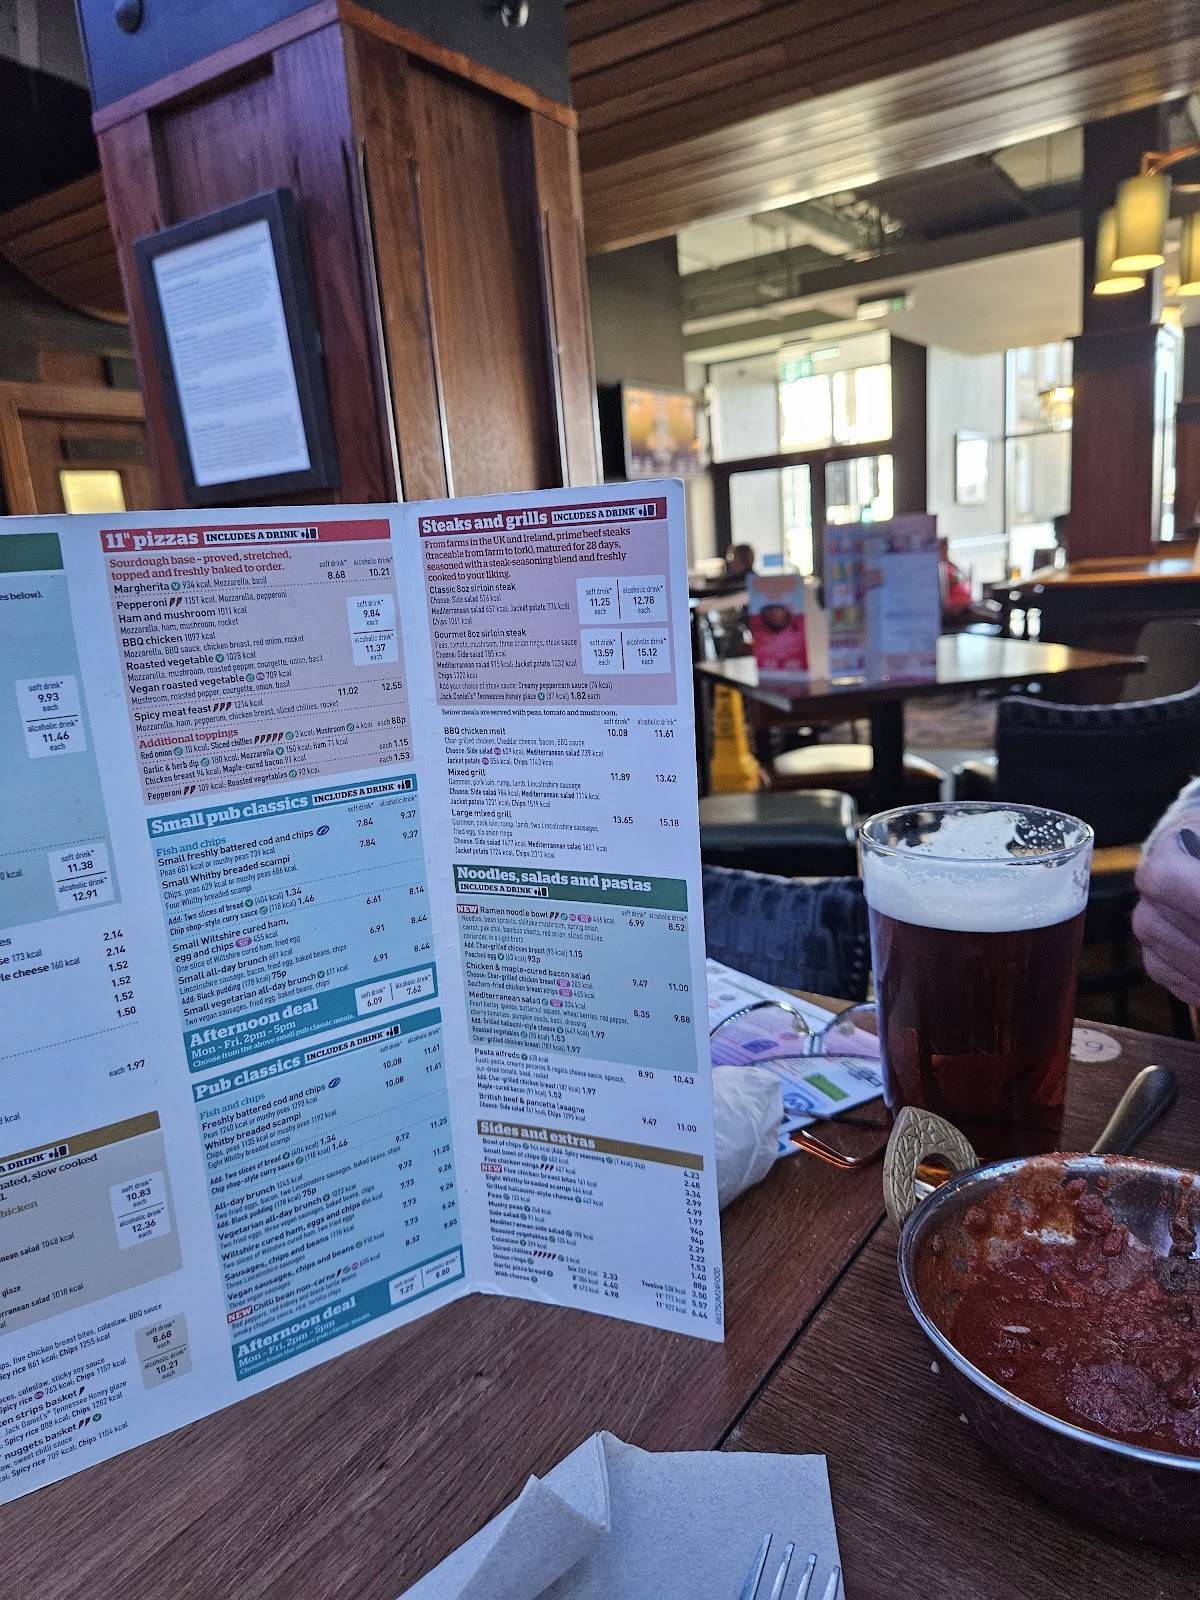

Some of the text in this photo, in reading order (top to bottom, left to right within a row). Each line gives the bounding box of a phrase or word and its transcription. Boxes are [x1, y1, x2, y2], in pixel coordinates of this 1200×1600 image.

[554, 510, 597, 521] INCLUDES
[598, 510, 605, 518] A
[422, 511, 548, 534] Steaks and grills
[133, 531, 199, 550] pizzas
[206, 531, 256, 541] INCLUDES
[258, 531, 265, 539] A
[425, 540, 446, 549] From
[447, 538, 470, 548] farms
[470, 537, 479, 545] in
[479, 536, 492, 545] the
[493, 535, 506, 544] UK
[507, 534, 522, 543] and
[556, 530, 582, 541] prime
[582, 529, 601, 538] beef
[603, 527, 631, 537] steaks
[110, 556, 170, 568] Sourdough
[171, 555, 195, 565] base
[203, 553, 242, 564] proved,
[112, 562, 284, 581] topped and freshly baked to order.
[327, 571, 346, 579] 8.68
[369, 568, 390, 577] 10.21
[114, 582, 170, 594] Margherita
[429, 586, 456, 594] Classic
[470, 583, 494, 592] sirloin
[495, 582, 517, 591] steak
[117, 598, 168, 611] Pepperoni
[590, 597, 611, 607] 11.25
[119, 608, 216, 623] Ham and mushroom
[363, 609, 381, 618] 9.84
[123, 635, 183, 647] BBQ chicken
[366, 643, 386, 653] 11.37
[594, 648, 614, 657] 13.59
[637, 648, 658, 657] 15.12
[127, 655, 214, 671] Roasted vegetable
[28, 683, 43, 692] soft
[130, 683, 160, 695] Vegan
[162, 679, 198, 691] roasted
[200, 675, 245, 688] vegetable
[338, 682, 403, 696] 11.02 12.55
[38, 692, 60, 703] 9.93
[134, 704, 211, 722] Spicy meat feast
[27, 722, 58, 732] alcoholic
[391, 716, 406, 726] 88p
[43, 731, 70, 742] 11.46
[444, 726, 506, 735] BBQ chicken melt
[607, 728, 628, 737] 10.08
[654, 729, 674, 738] 11.61
[140, 728, 239, 749] Additional toppings
[448, 768, 486, 777] Mixed grill
[610, 772, 631, 781] 11.89
[656, 774, 677, 783] 13.42
[314, 789, 358, 803] INCLUDES
[359, 788, 367, 796] A
[151, 796, 309, 834] Small pub classics
[400, 810, 416, 819] 9.37
[451, 808, 512, 819] Large mixed grill
[357, 818, 374, 827] 7.84
[402, 830, 418, 839] 9.37
[157, 837, 227, 857] Fish and chips
[158, 830, 314, 867] Small freshly battered cod and chips
[359, 839, 376, 848] 7.84
[67, 860, 94, 873] 11.38
[162, 855, 290, 889] Small Whitby breaded scampi
[457, 866, 652, 892] Noodles, salads and pastas
[409, 886, 425, 895] 8.14
[460, 883, 499, 892] INCLUDES
[72, 888, 98, 901] 12.91
[457, 904, 549, 918] NEW Ramen noodle bowl
[411, 914, 428, 924] 8.44
[628, 919, 645, 928] 6.99
[668, 923, 685, 932] 8.52
[103, 929, 123, 941] 2.14
[13, 964, 49, 979] cheese
[178, 955, 268, 985] Small all-day brunch
[271, 970, 287, 981] 75p
[632, 978, 648, 988] 9.47
[668, 982, 689, 992] 11.00
[183, 973, 317, 1017] Small vegetarian all-day brunch
[116, 1005, 137, 1018] 1.50
[190, 1011, 281, 1048] Afternoon
[282, 998, 319, 1019] deal
[191, 1044, 217, 1060] Mon
[243, 1030, 267, 1044] 2pm
[274, 1021, 297, 1035] 5pm
[307, 1043, 349, 1061] INCLUDES
[349, 1040, 356, 1048] A
[195, 1057, 301, 1099] Pub classics
[480, 1121, 596, 1149] Sides and extras
[32, 1153, 98, 1180] slow cooked
[683, 1170, 700, 1180] 4.23
[126, 1187, 151, 1202] 10.83
[132, 1219, 157, 1233] 12.36
[237, 1295, 357, 1358] Afternoon deal
[152, 1330, 172, 1344] 8.68
[156, 1360, 179, 1374] 10.21
[15, 1404, 44, 1422] strips
[45, 1390, 77, 1410] basket
[4, 1424, 77, 1460] nuggets basket
